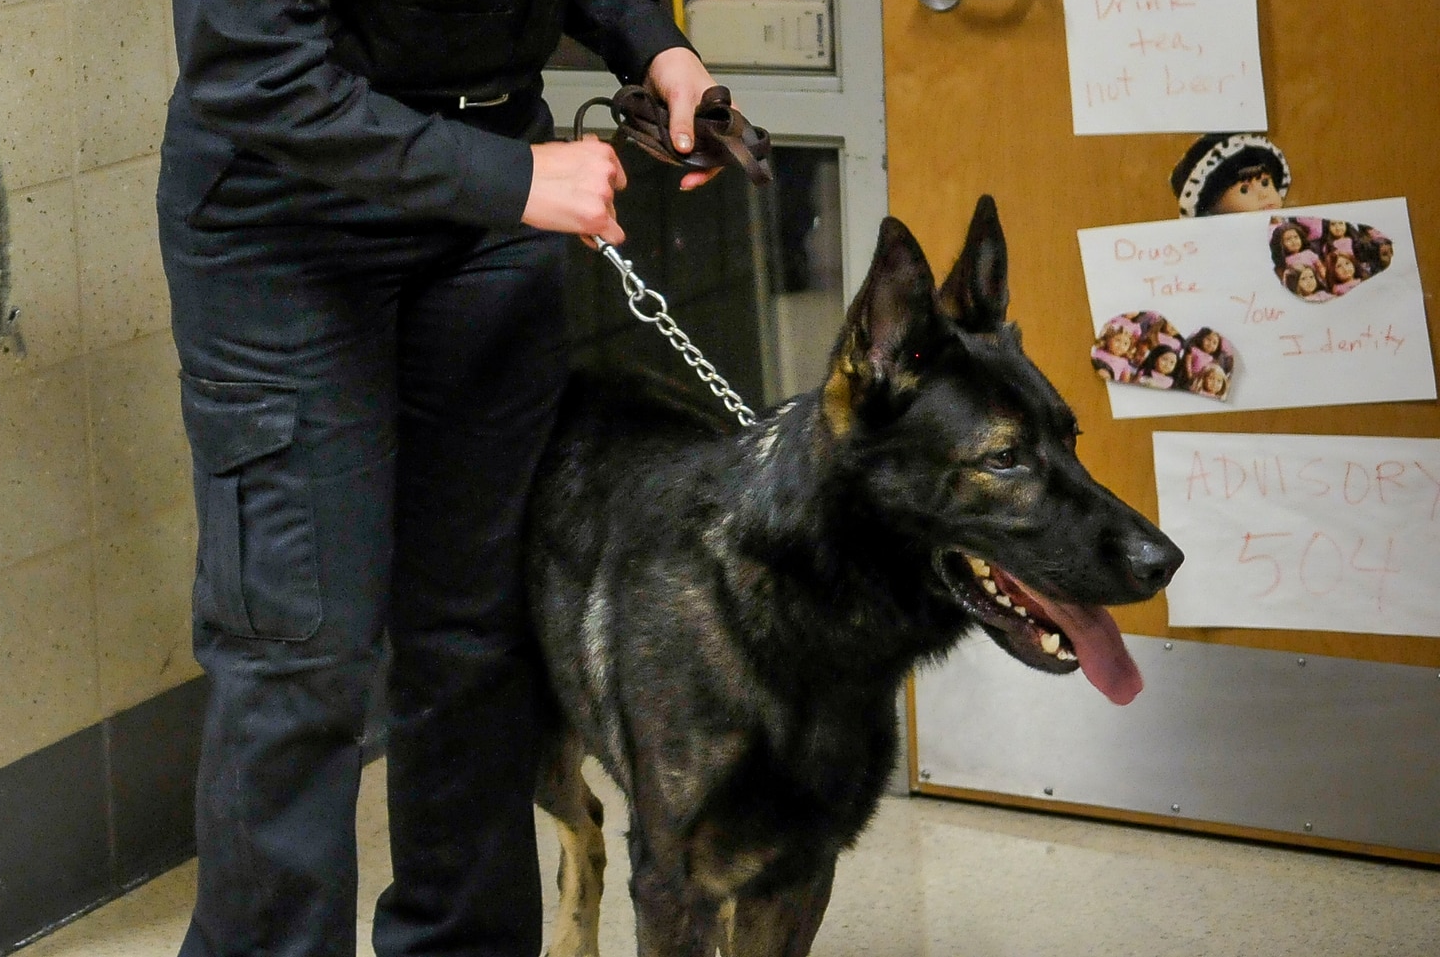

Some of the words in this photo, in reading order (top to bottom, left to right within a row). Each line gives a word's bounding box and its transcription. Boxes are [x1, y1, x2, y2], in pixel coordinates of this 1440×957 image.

[1129, 28, 1203, 56] tea,
[1164, 60, 1247, 108] beer!
[1114, 238, 1199, 264] Drugs
[1143, 275, 1201, 296] Take
[1230, 293, 1286, 324] Your
[1186, 450, 1440, 522] ADVISORY
[1238, 531, 1402, 612] 504
